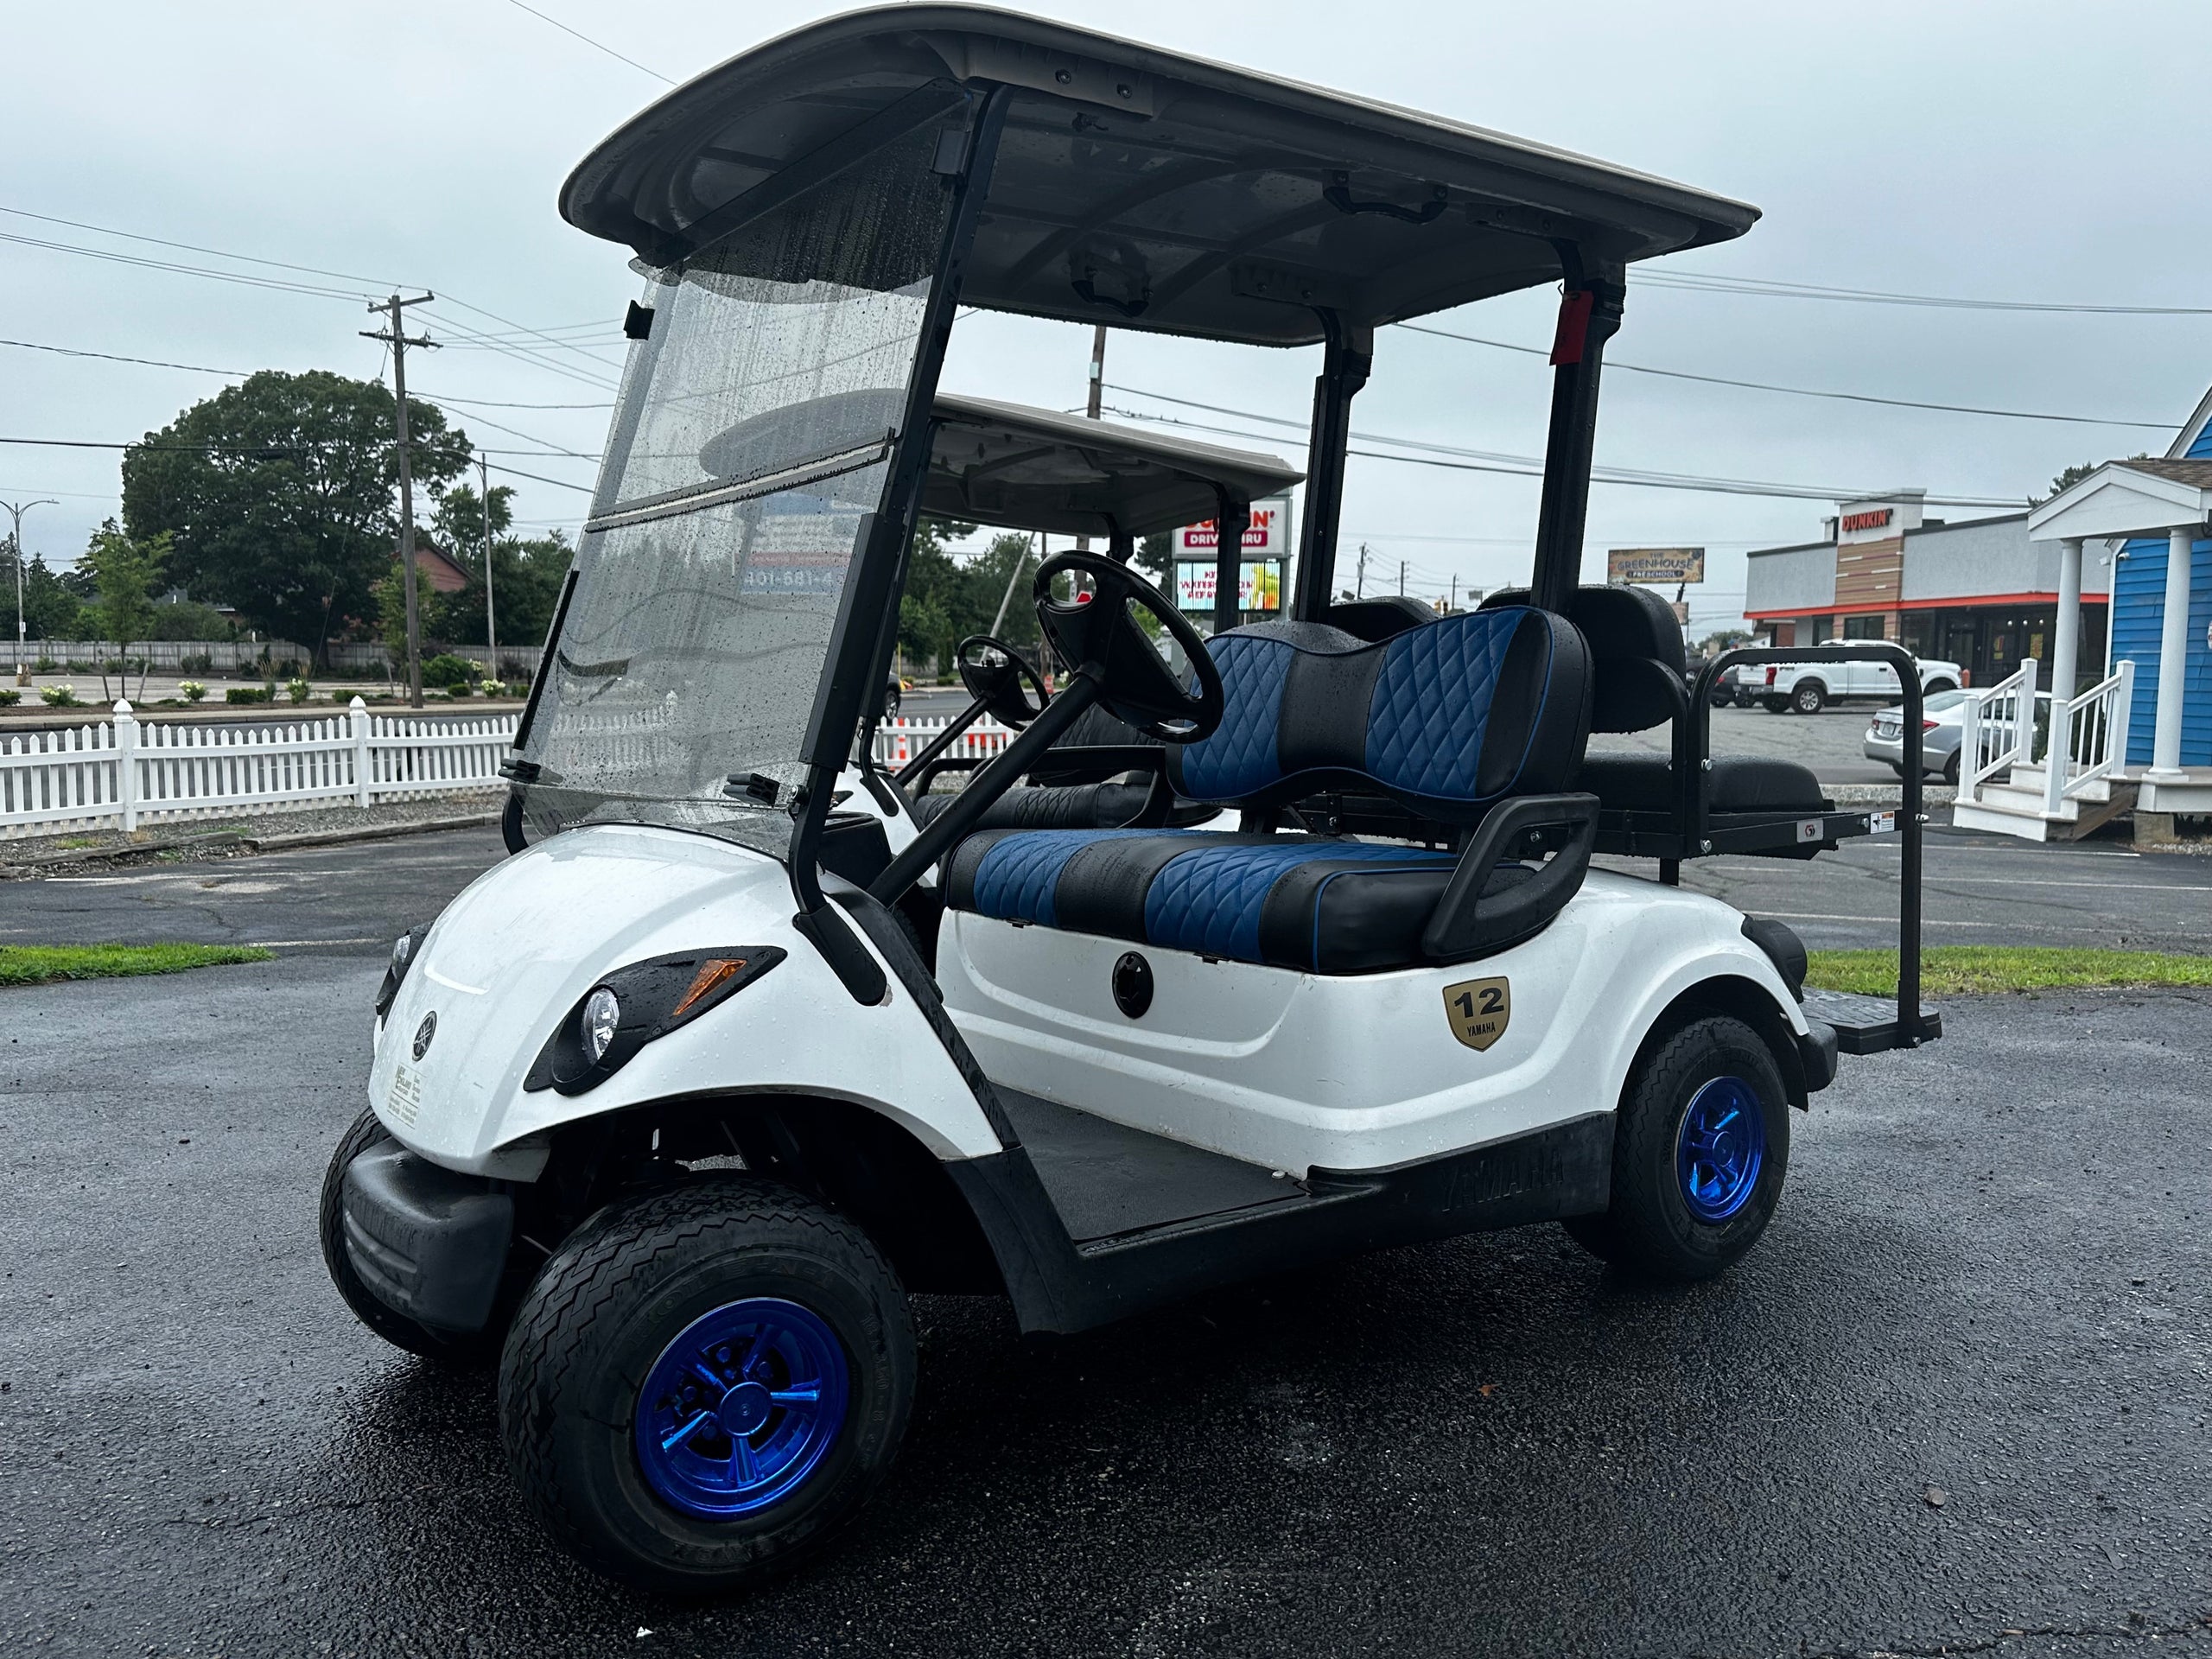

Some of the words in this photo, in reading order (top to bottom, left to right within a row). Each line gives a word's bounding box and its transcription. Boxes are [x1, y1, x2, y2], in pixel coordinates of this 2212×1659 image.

[1842, 508, 1893, 532] DUNKIN'
[1190, 534, 1219, 545] DRIV
[1618, 557, 1694, 570] GREENHOUSE
[1454, 988, 1504, 1018] 12
[1467, 1021, 1496, 1037] YAMAHA
